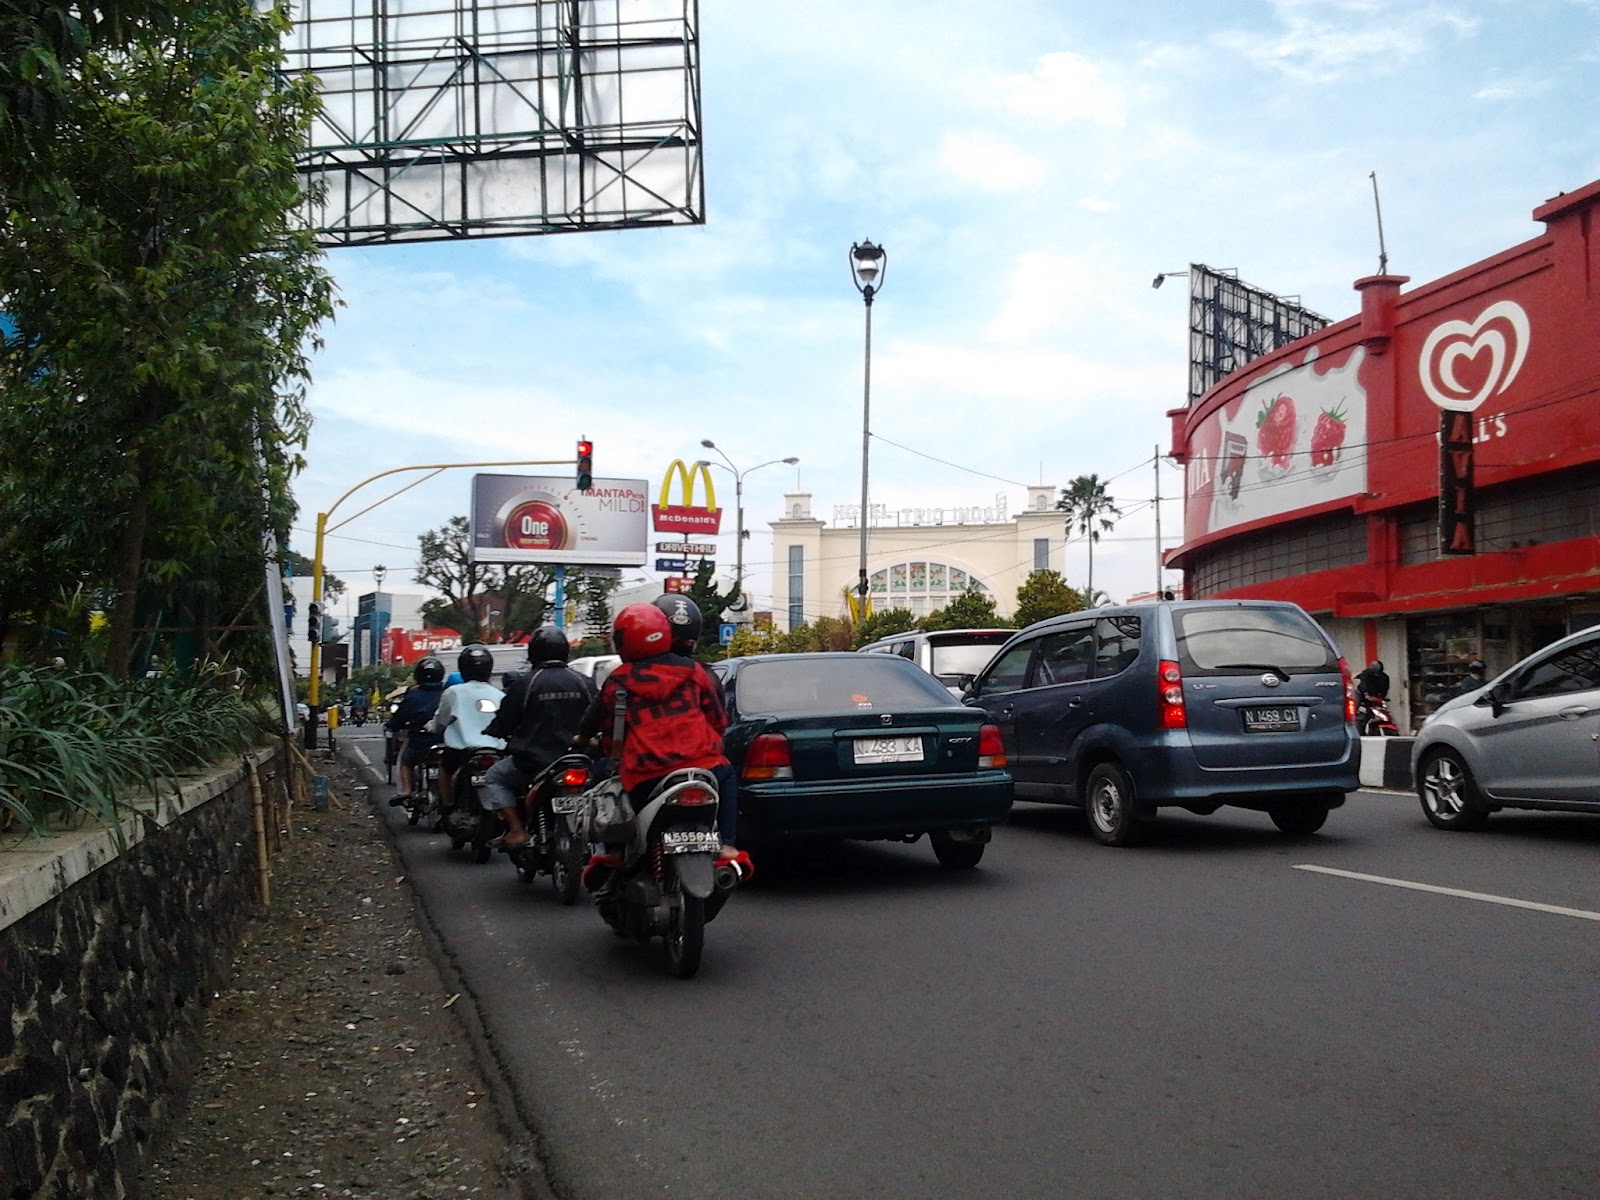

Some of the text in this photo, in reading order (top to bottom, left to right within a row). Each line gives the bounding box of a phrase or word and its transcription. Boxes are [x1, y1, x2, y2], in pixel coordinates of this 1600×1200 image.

[599, 499, 645, 513] MILD!
[659, 514, 717, 524] McDonald's
[901, 507, 944, 525] TRIO
[952, 505, 1008, 523] INDAH
[521, 515, 549, 535] One
[1245, 708, 1297, 723] N 1469 CY
[902, 737, 922, 753] KA
[705, 831, 720, 841] AK
